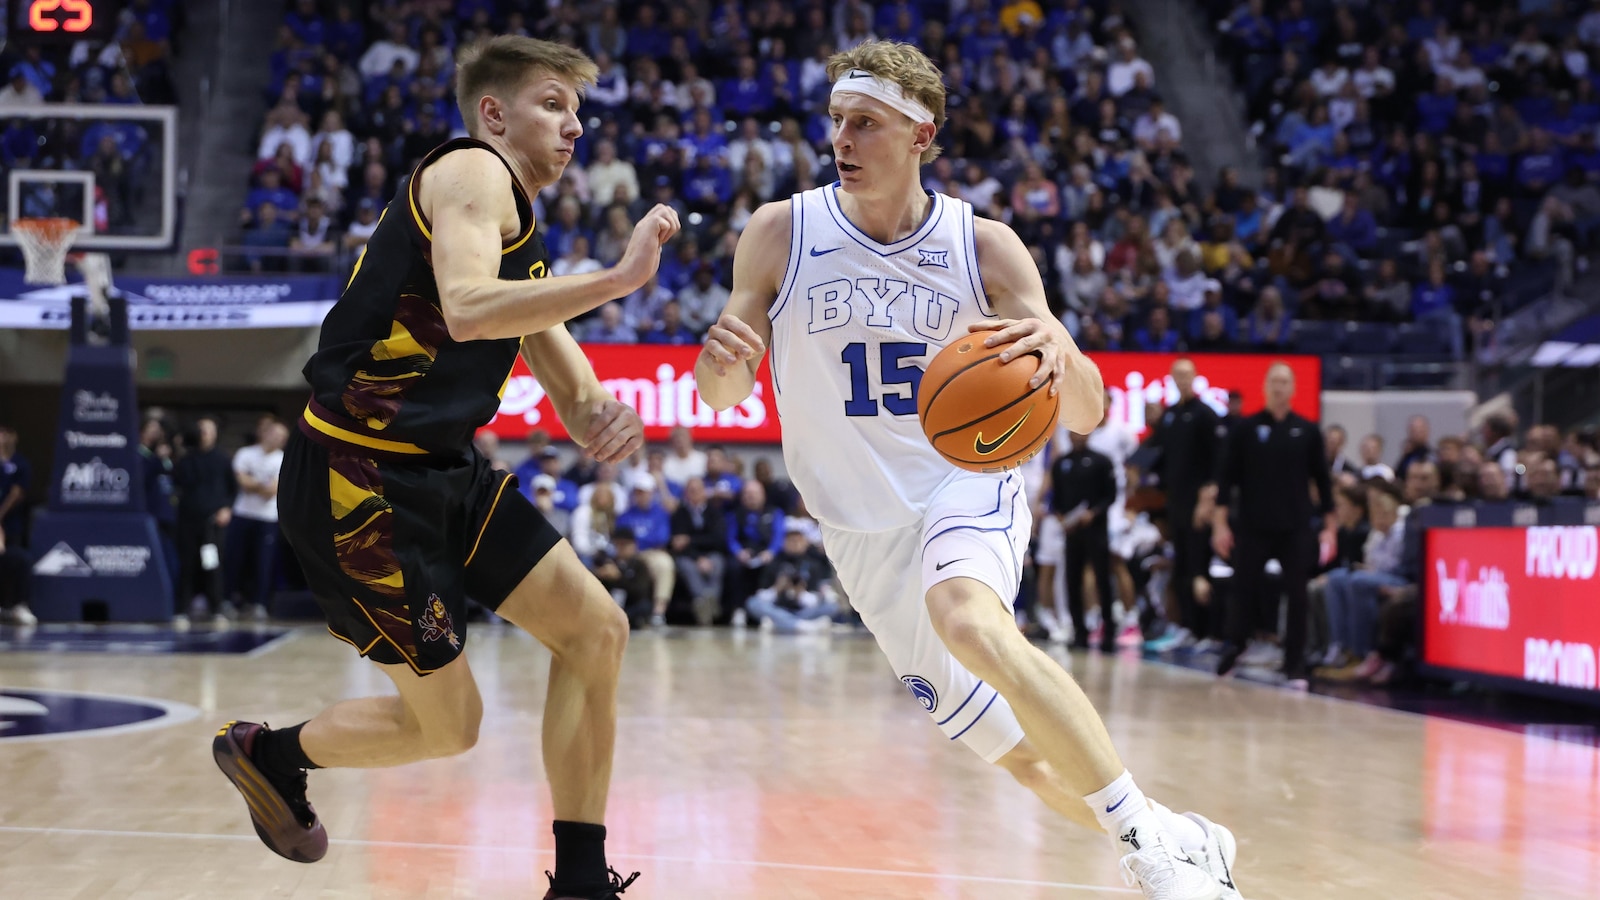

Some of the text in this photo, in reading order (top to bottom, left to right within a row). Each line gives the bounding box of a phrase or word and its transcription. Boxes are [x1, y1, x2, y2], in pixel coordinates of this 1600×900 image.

[918, 249, 949, 268] XII
[808, 278, 960, 341] BYU
[841, 342, 928, 416] 15
[1525, 525, 1598, 580] PROUD
